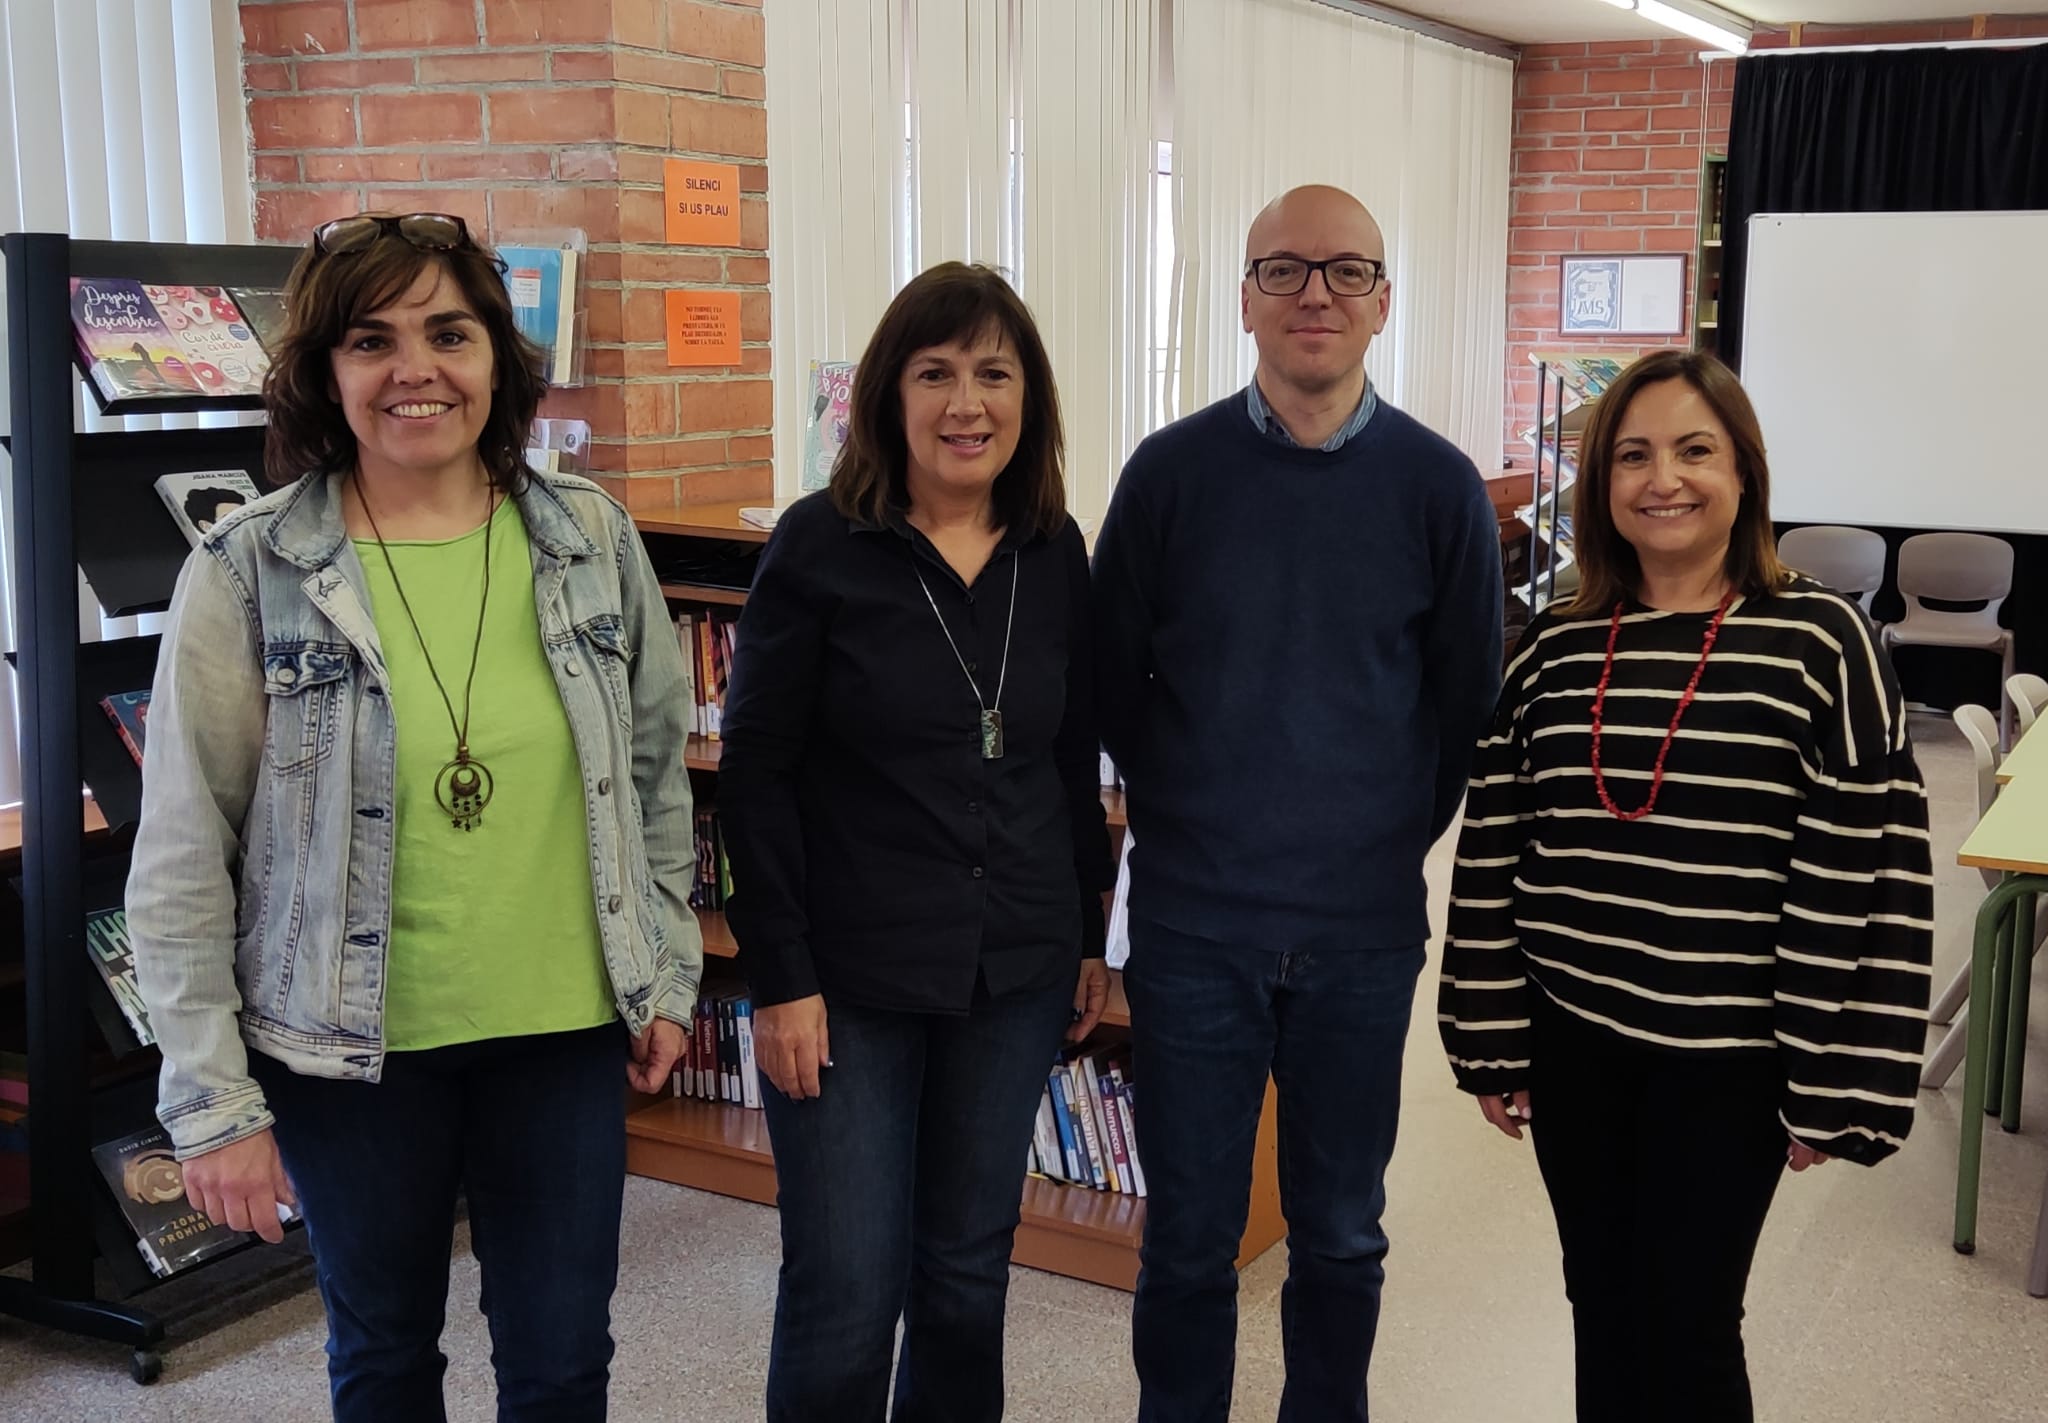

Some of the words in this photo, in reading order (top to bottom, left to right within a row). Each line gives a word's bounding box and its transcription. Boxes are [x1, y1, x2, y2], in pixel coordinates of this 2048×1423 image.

[686, 178, 721, 192] SILENCI
[679, 202, 688, 214] SI
[690, 203, 703, 215] US
[705, 204, 729, 217] PLAU
[84, 303, 160, 331] desembre
[704, 1020, 712, 1055] Vietnam
[1104, 1099, 1122, 1155] Marruecos
[158, 1220, 216, 1247] PROHIBI
[170, 1211, 205, 1230] ZONA
